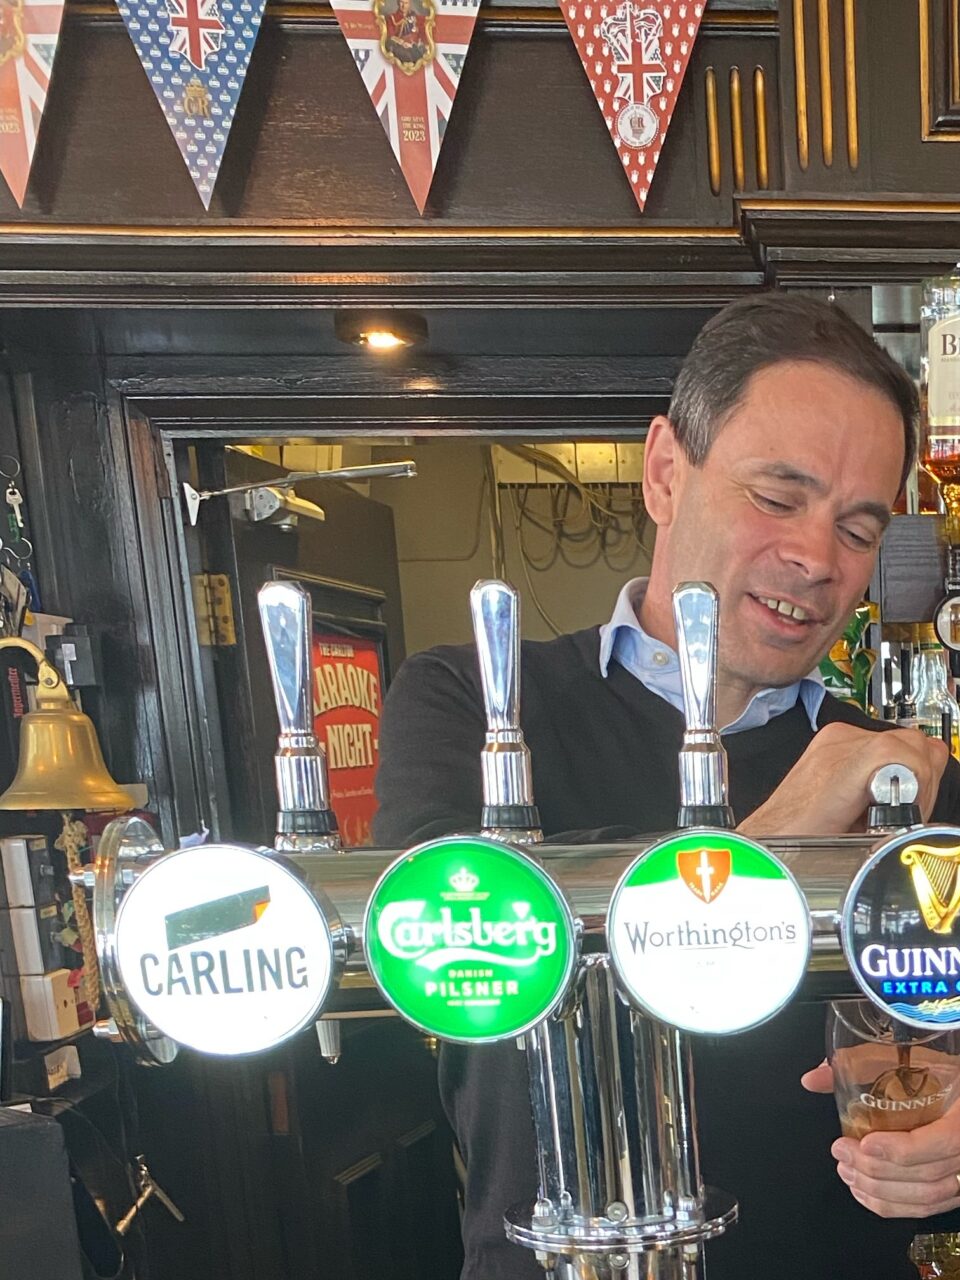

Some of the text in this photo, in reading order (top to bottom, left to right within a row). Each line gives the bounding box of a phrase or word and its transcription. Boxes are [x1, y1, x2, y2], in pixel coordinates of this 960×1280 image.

[0, 122, 21, 134] 023
[402, 129, 426, 142] 2023
[313, 662, 379, 717] ARAOKE
[325, 723, 374, 769] NIGHT
[377, 899, 558, 968] Carlsberg
[623, 918, 797, 955] Worthington's
[139, 946, 308, 997] CARLING
[448, 969, 493, 978] DANISH
[424, 980, 519, 998] PILSNER
[883, 980, 948, 995] EXTRA
[859, 1083, 954, 1112] GUINNESS
